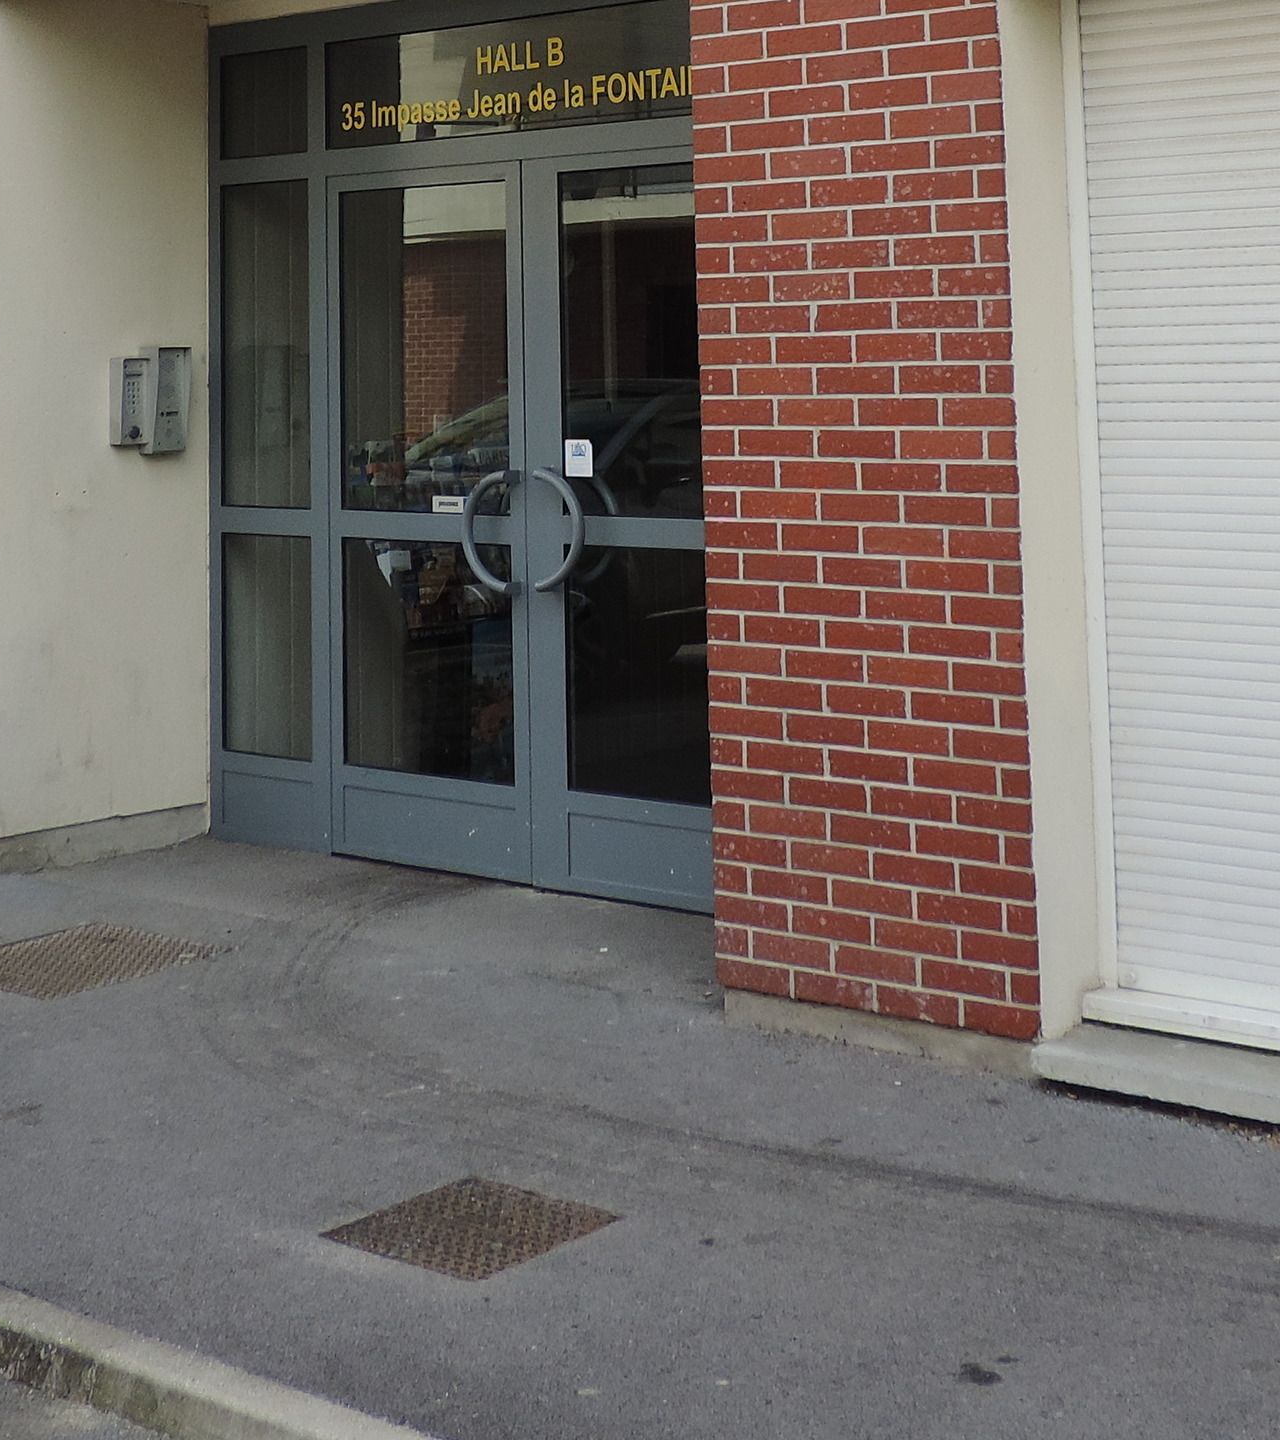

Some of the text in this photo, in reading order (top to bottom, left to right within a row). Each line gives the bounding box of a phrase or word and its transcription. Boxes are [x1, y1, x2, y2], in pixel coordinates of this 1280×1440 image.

[476, 36, 565, 76] HALL B
[341, 65, 693, 133] 35 Impasse Jean de la FONTAI
